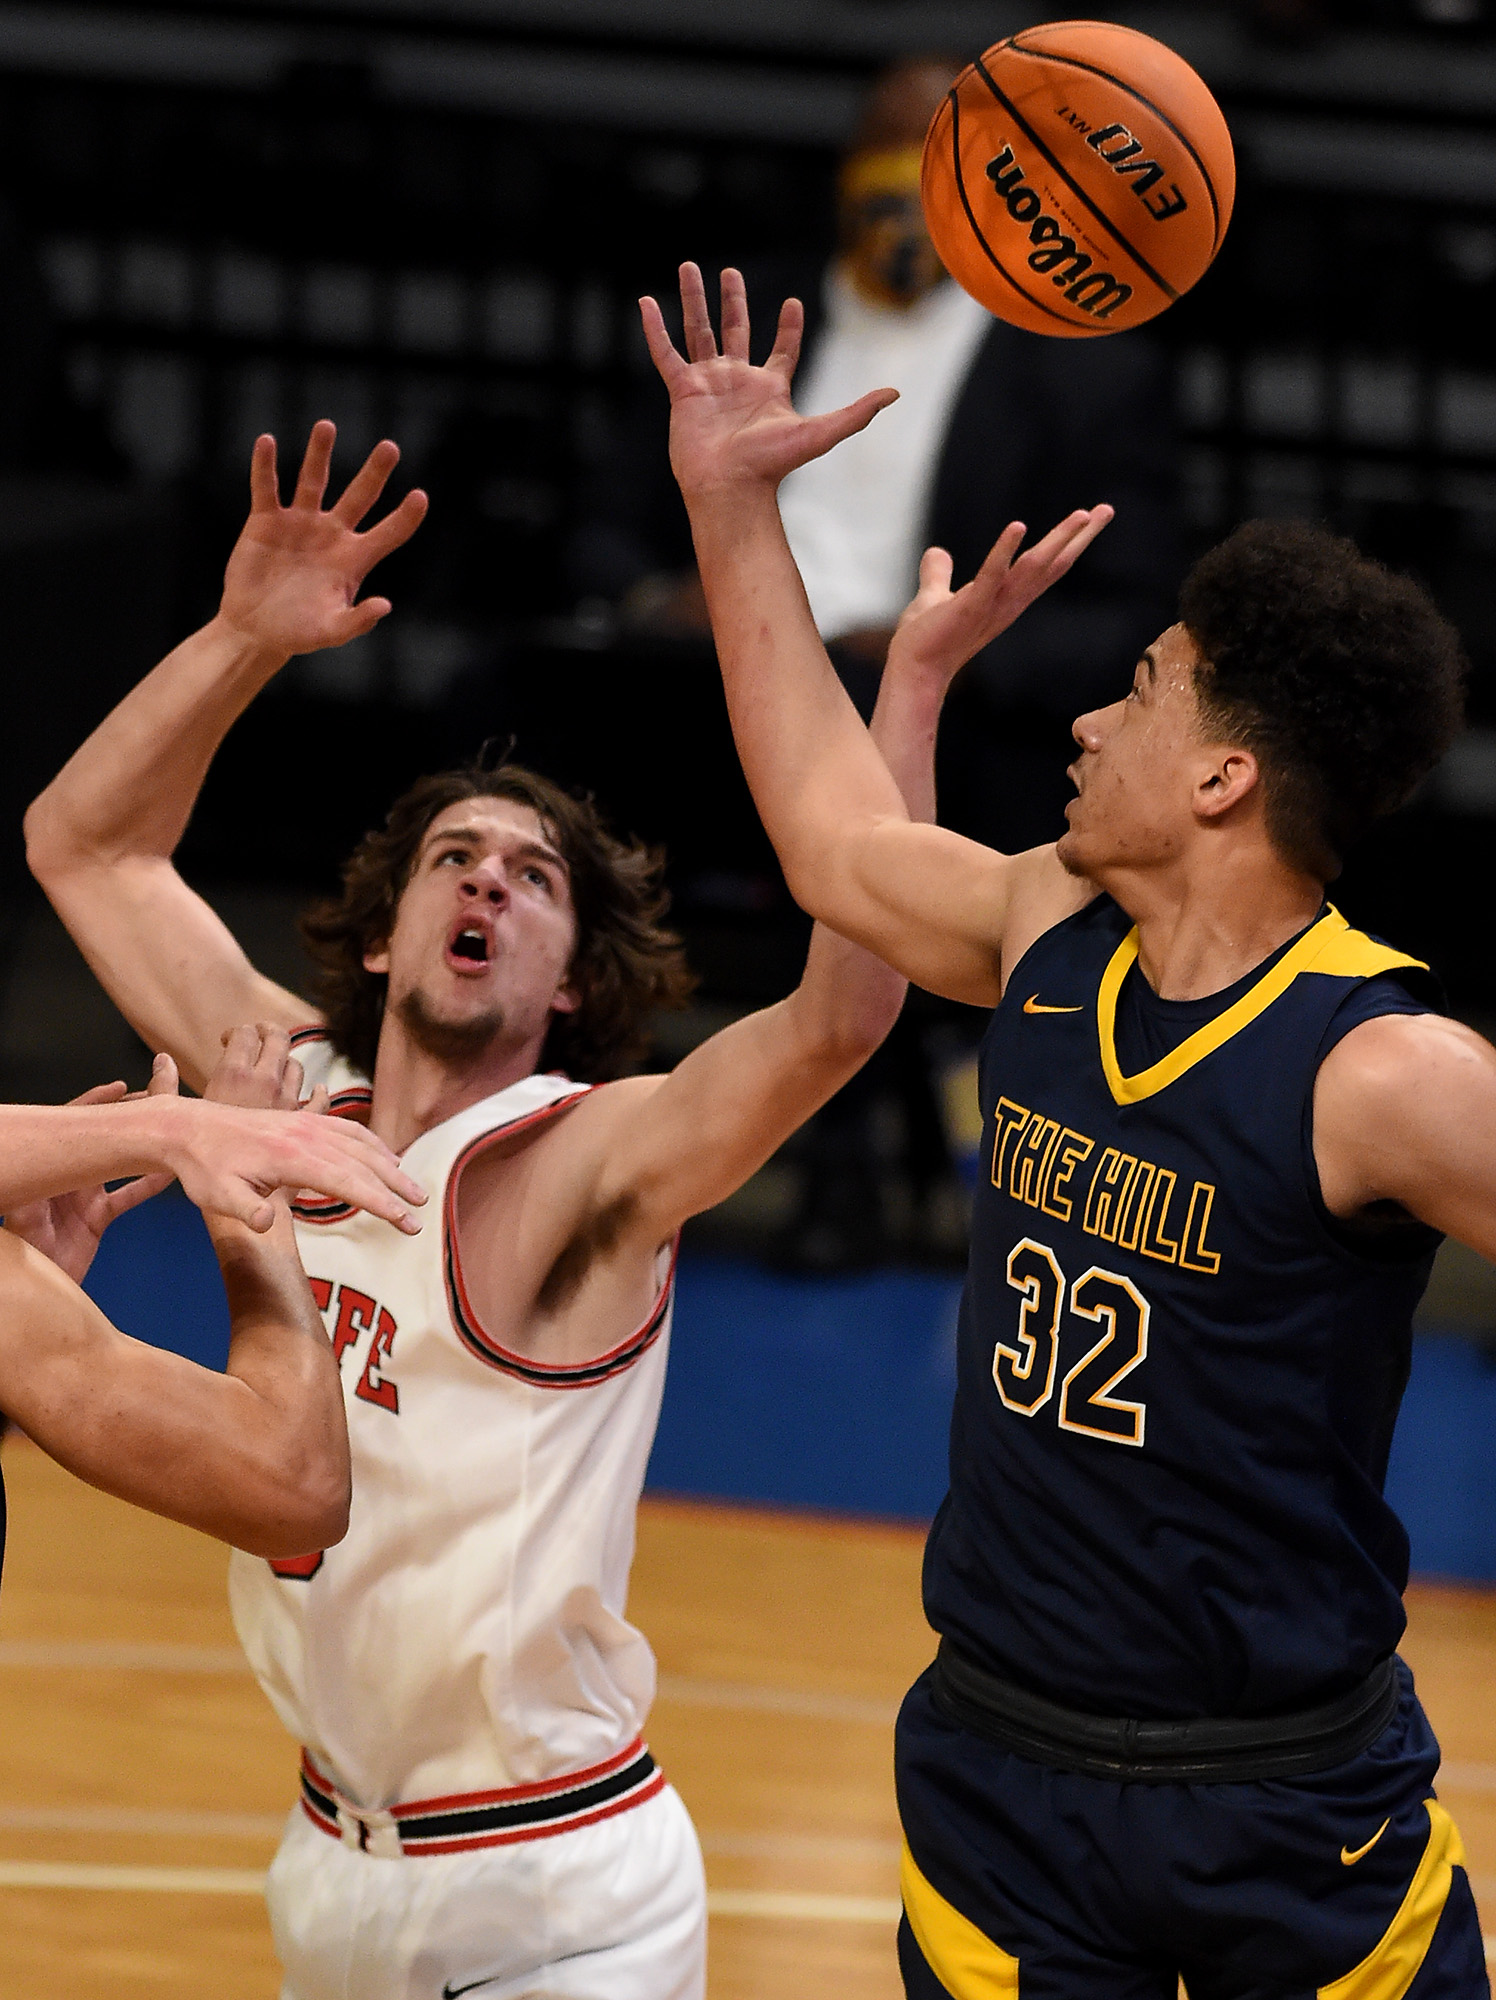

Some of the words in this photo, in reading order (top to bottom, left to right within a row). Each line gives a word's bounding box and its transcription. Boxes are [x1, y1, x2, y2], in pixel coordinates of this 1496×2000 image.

[1055, 105, 1092, 135] NXT
[1085, 122, 1188, 222] EVO
[985, 143, 1134, 319] Wilson
[991, 1096, 1095, 1222] THE
[1083, 1147, 1221, 1274] HILL
[992, 1237, 1151, 1447] 32
